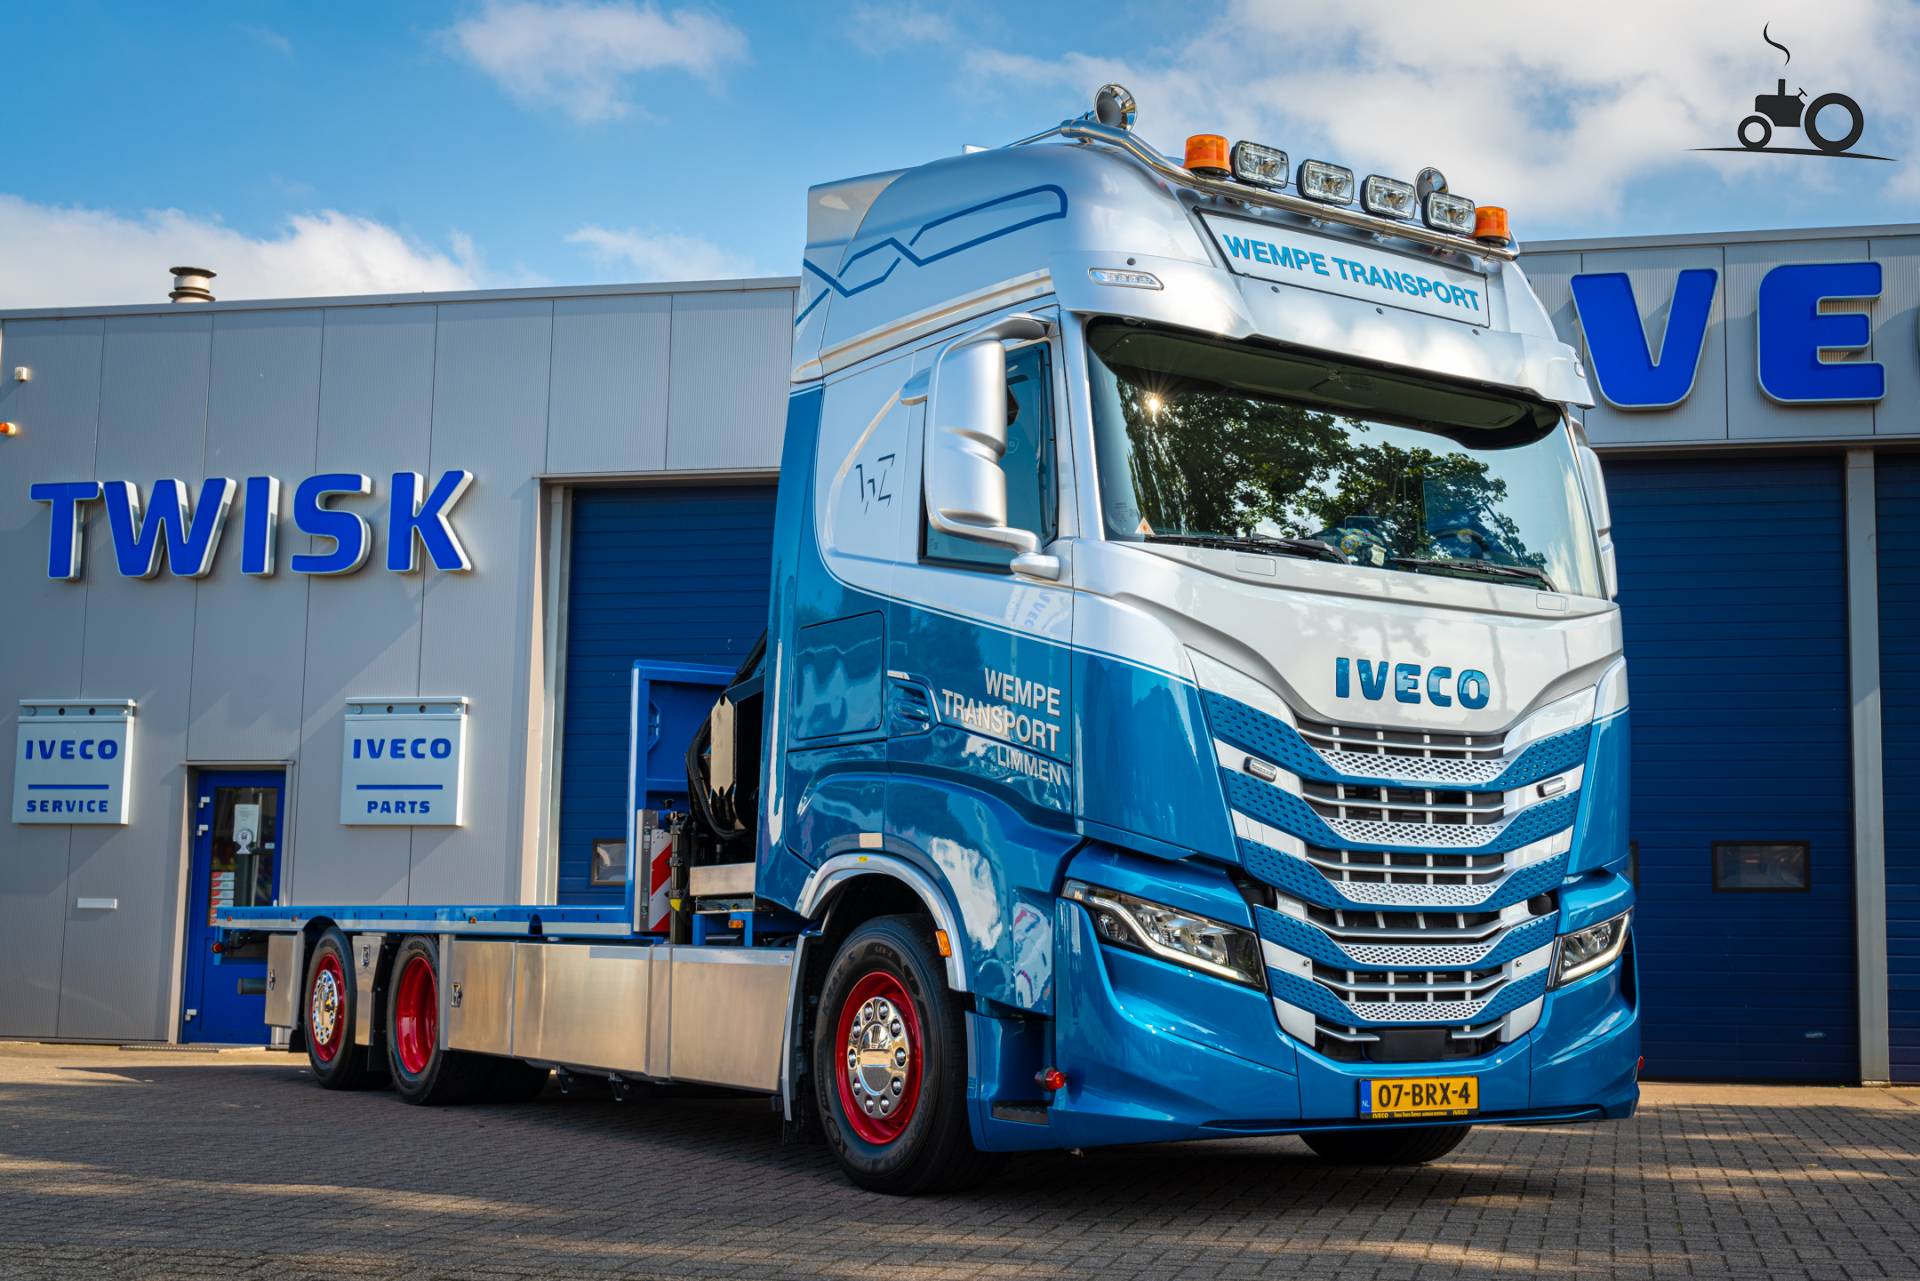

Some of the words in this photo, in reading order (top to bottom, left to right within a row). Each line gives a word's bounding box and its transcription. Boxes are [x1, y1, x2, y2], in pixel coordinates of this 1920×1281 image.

[1223, 234, 1330, 276] WEMPE
[1331, 257, 1479, 311] TRANSPORT
[1570, 261, 1920, 411] VE
[30, 470, 474, 580] TWISK
[984, 667, 1061, 717] WEMPE
[1335, 657, 1490, 710] IVECO
[942, 689, 1061, 752] TRANSPORT
[25, 739, 119, 761] IVECO
[352, 738, 452, 760] IVECO
[997, 745, 1061, 786] LIMMEN
[26, 799, 109, 814] SERVICE
[366, 800, 431, 814] PARTS
[1378, 1082, 1471, 1108] 07-BRX-4
